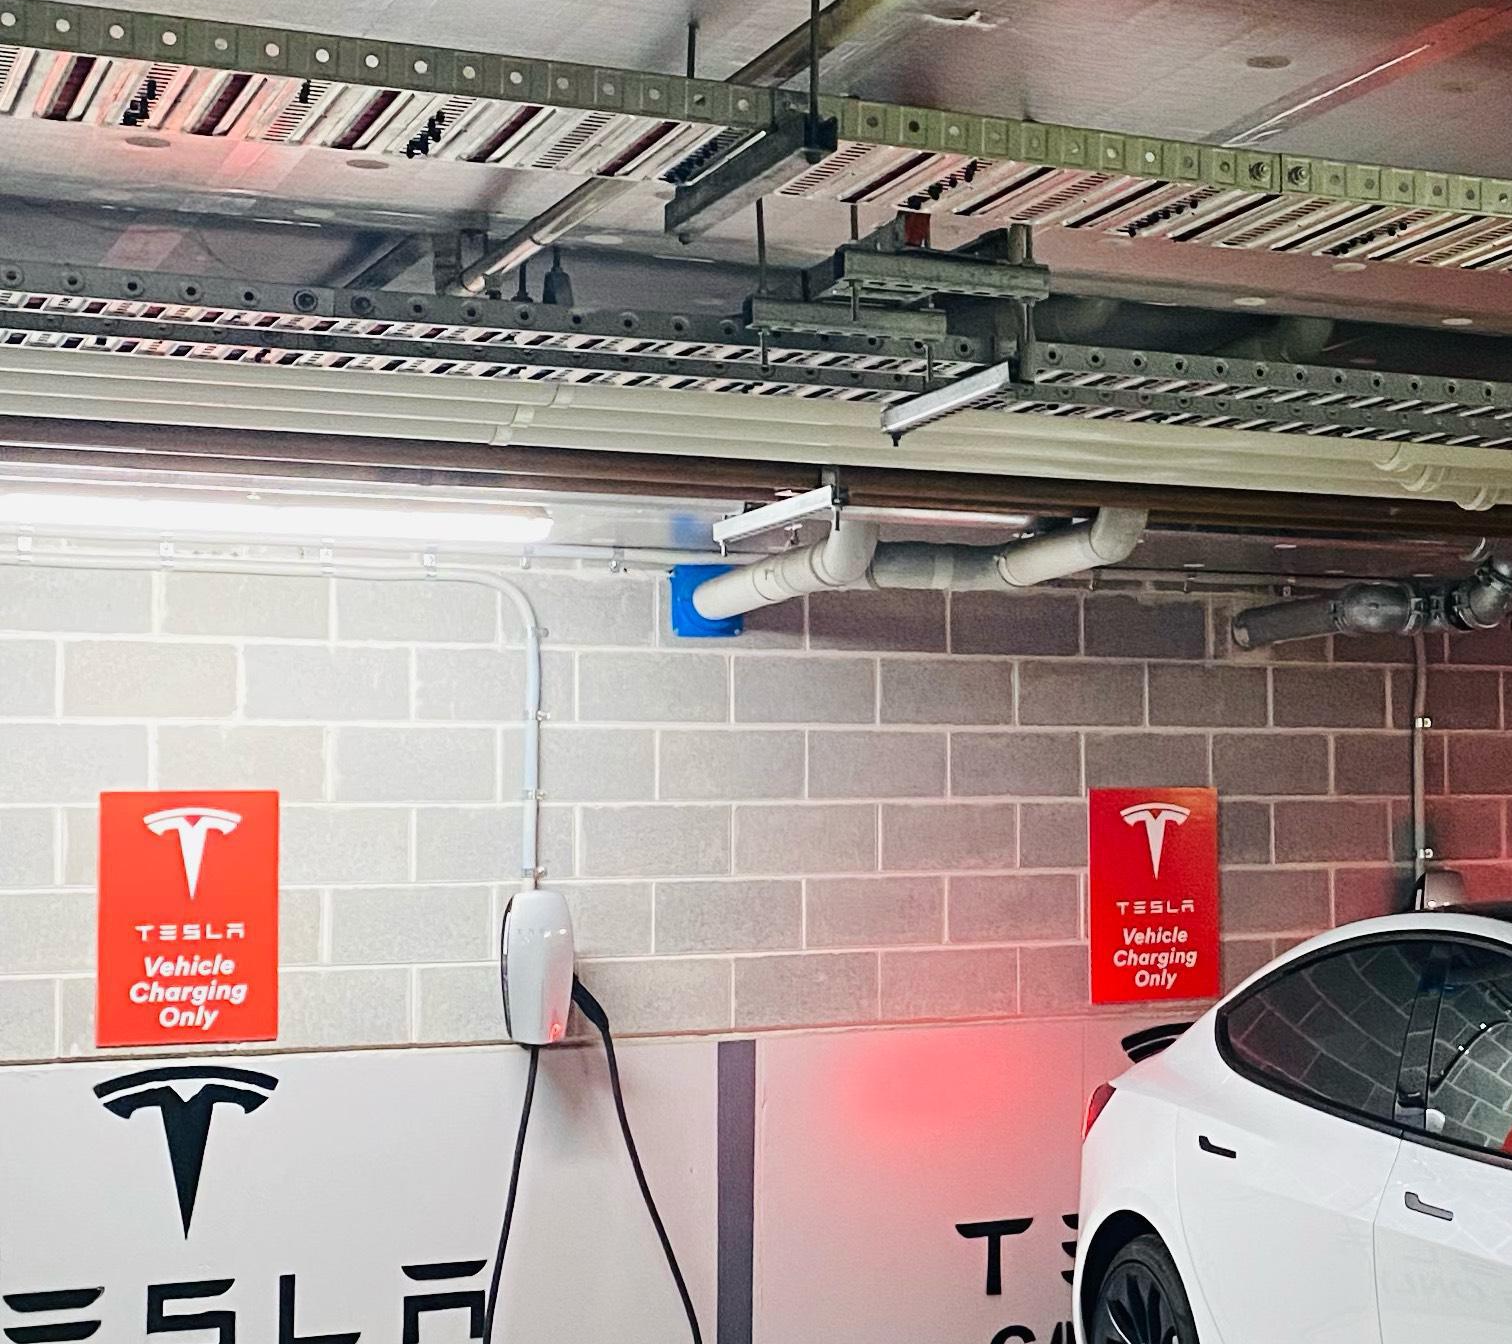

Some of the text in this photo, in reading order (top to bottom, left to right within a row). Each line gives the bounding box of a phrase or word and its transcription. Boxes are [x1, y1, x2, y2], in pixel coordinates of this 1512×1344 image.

[1115, 899, 1195, 916] TESLA
[134, 922, 245, 941] TESLA
[1122, 926, 1188, 946] Vehicle
[143, 953, 235, 977] Vehicle
[1112, 947, 1198, 970] Charging
[1134, 969, 1178, 990] Only
[129, 979, 248, 1005] Charging
[158, 1005, 219, 1030] Only
